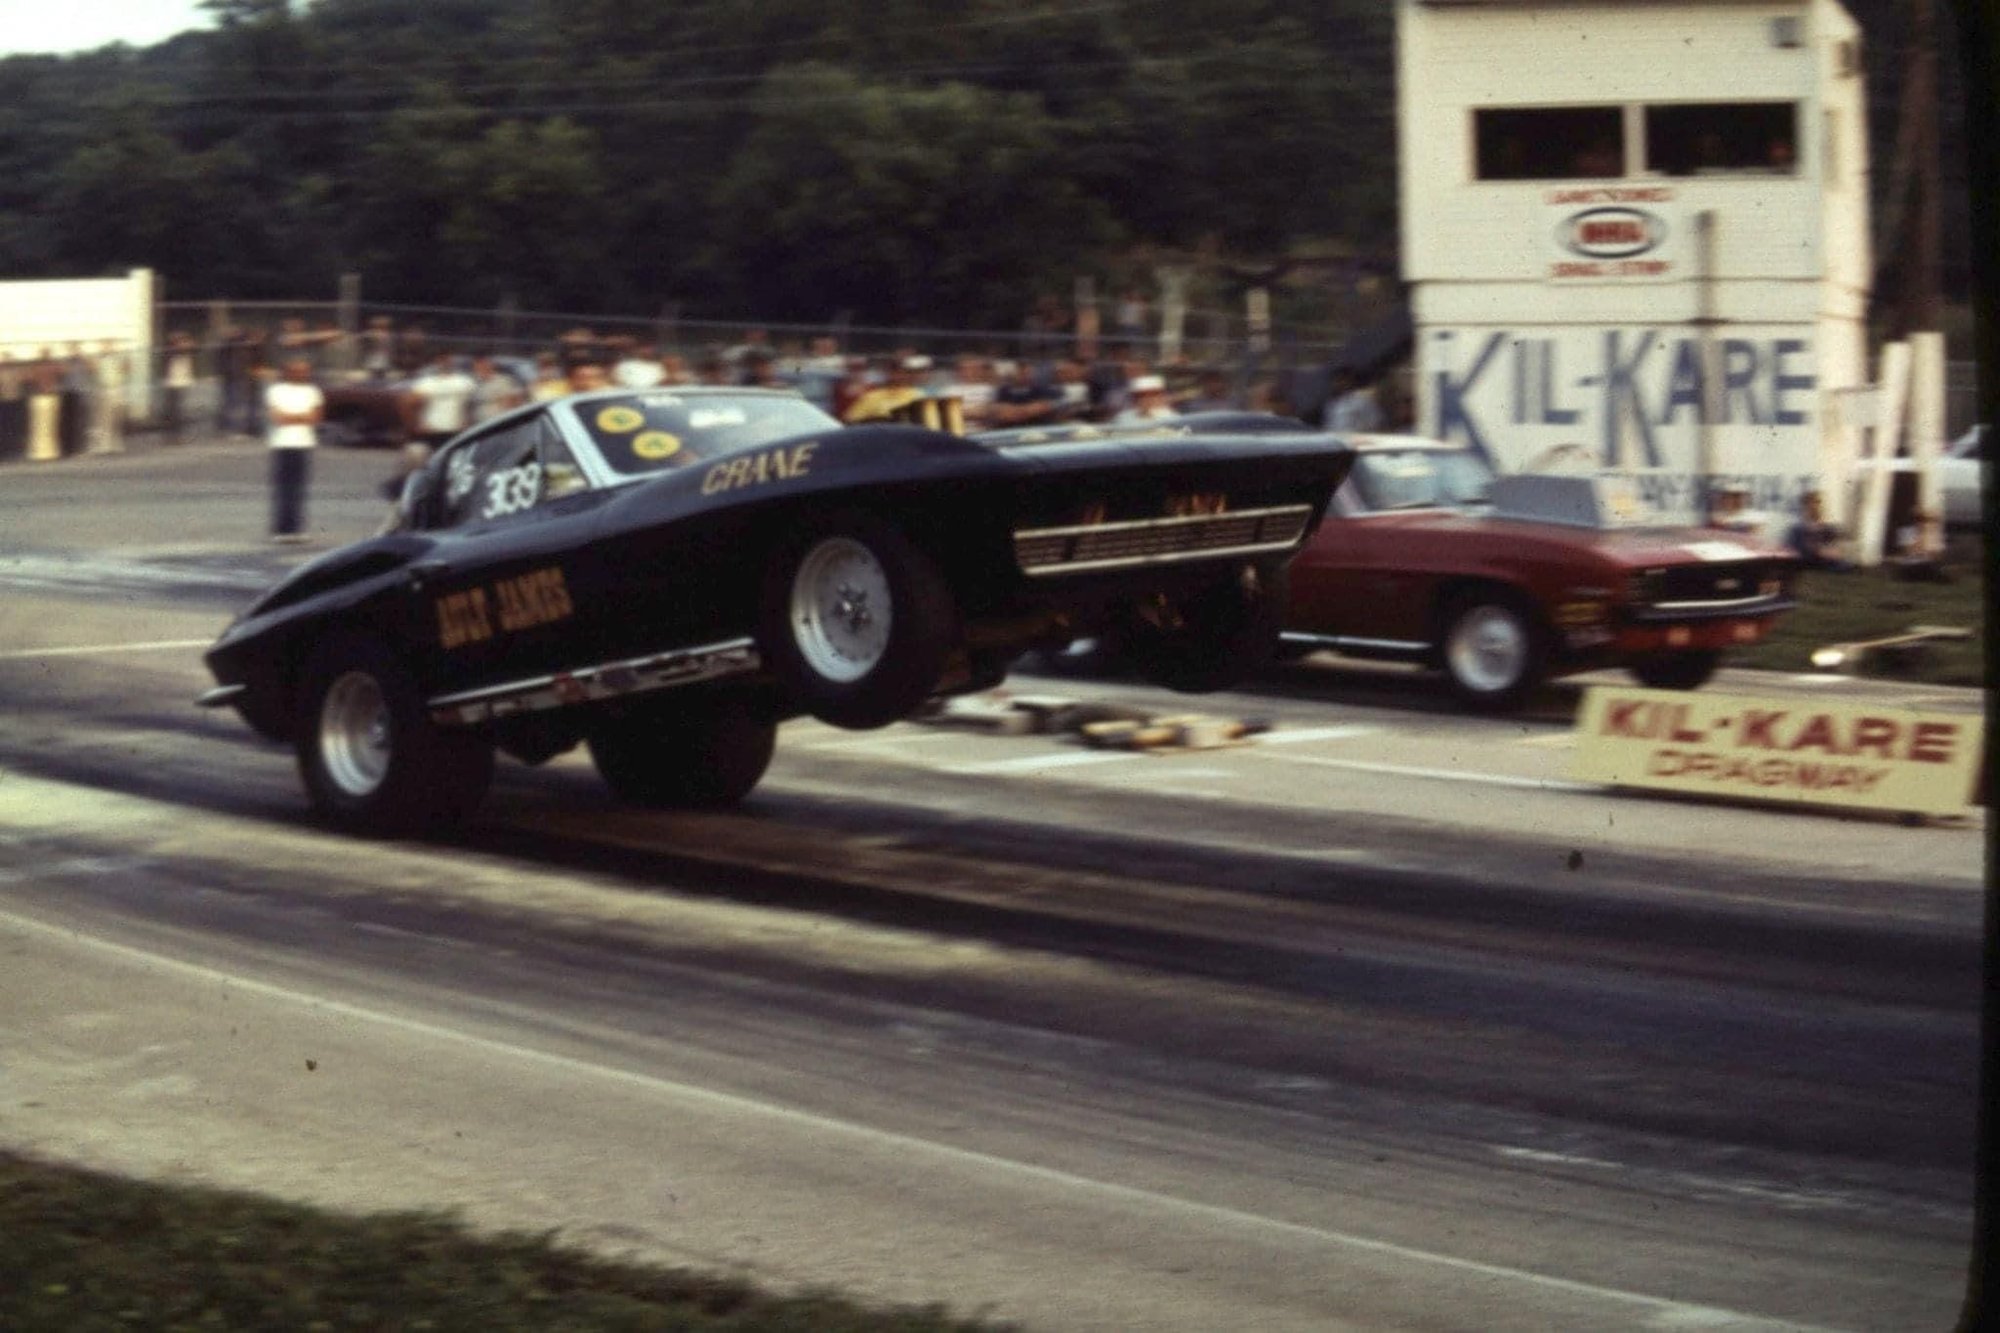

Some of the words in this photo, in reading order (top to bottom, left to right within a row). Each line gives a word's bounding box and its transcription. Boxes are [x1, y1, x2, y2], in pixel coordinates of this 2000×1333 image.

[1433, 328, 1819, 474] KIL-KARE
[702, 441, 818, 495] CRANE
[1646, 748, 1891, 792] DRAGWAY
